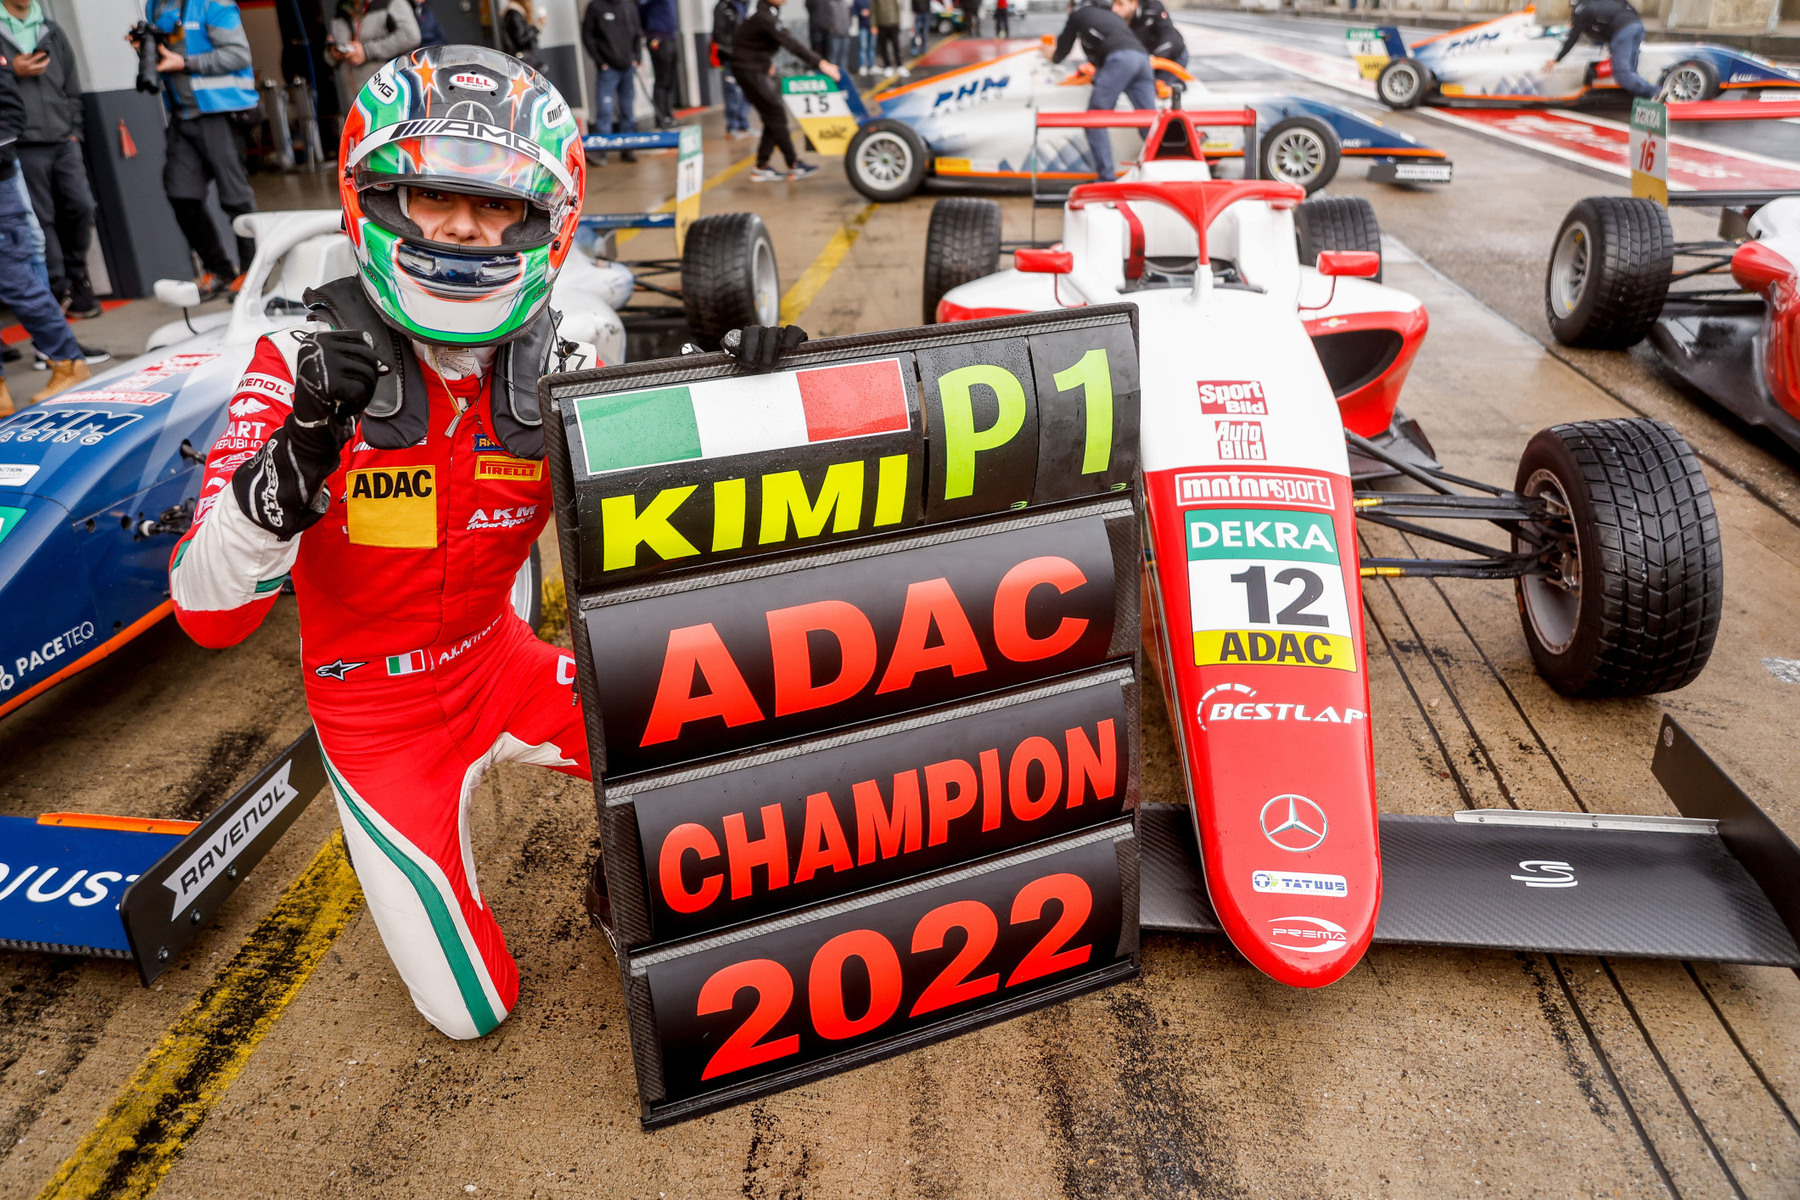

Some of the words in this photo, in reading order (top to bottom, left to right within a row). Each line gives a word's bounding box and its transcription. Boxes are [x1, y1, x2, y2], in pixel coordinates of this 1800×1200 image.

[373, 74, 395, 98] AMG
[456, 75, 491, 87] BELL
[934, 76, 1010, 108] PHM
[804, 96, 830, 114] 15
[1634, 105, 1660, 129] DEKRA
[435, 121, 541, 160] AMG
[1639, 139, 1655, 173] 16
[1199, 381, 1264, 405] Sport
[1225, 400, 1265, 414] Bild
[0, 429, 104, 446] ACING
[220, 420, 266, 439] ART
[1216, 421, 1261, 441] Auto
[1219, 440, 1264, 460] Bild
[479, 460, 536, 477] PIRELLI
[352, 469, 433, 499] ADAC
[1182, 475, 1327, 503] motorsport
[602, 453, 909, 573] KIMI
[1190, 520, 1335, 553] DEKRA
[1230, 565, 1330, 628] 12
[15, 620, 94, 678] PACETEQ
[639, 555, 1090, 748] ADAC
[1219, 631, 1333, 665] ADAC
[1209, 702, 1365, 724] BESTLAP
[658, 718, 1118, 914] CHAMPION
[180, 783, 286, 896] RAVENOL
[1282, 878, 1346, 892] TATUUS
[1272, 928, 1347, 941] PREMA
[696, 872, 1094, 1082] 2022
